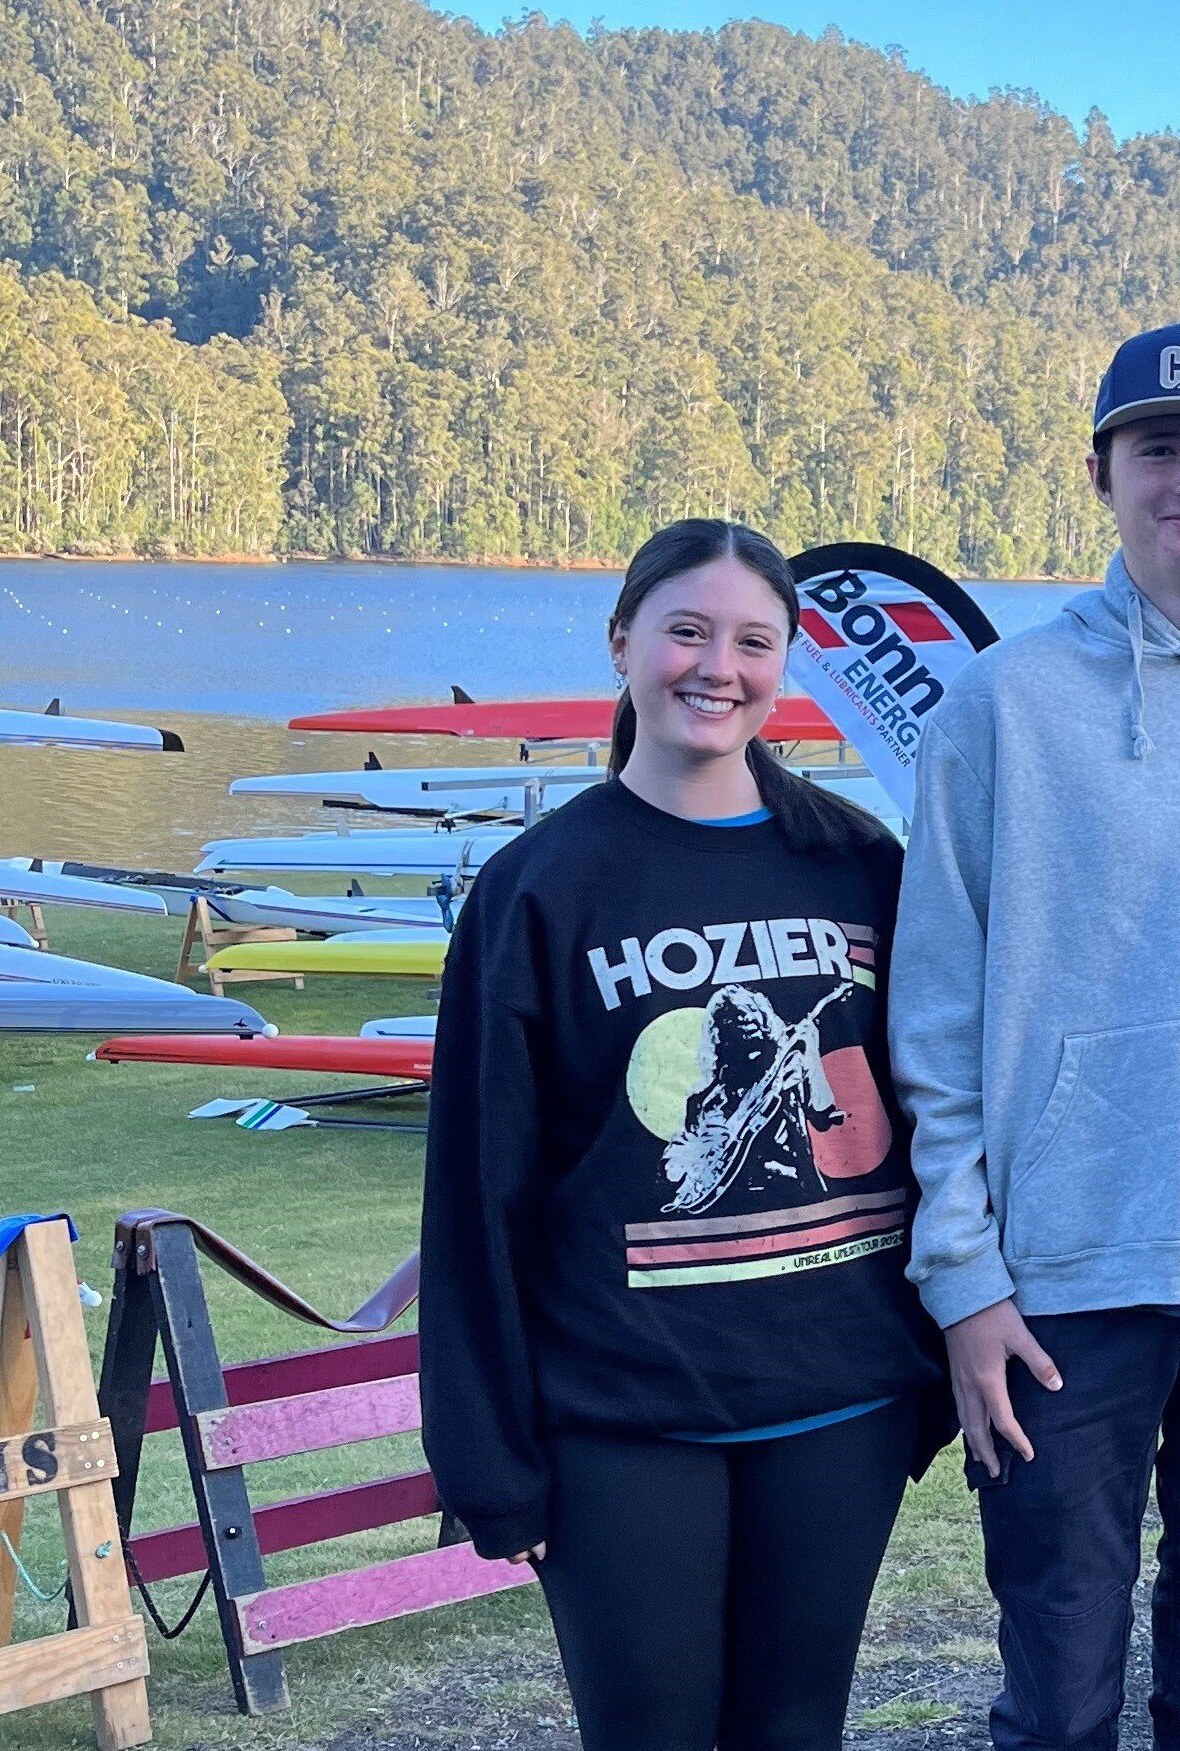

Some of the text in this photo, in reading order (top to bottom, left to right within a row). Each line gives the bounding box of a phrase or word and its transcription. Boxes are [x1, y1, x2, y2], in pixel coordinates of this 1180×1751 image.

[802, 639, 911, 767] FUEL & LUBRICANTS PARTNER
[842, 658, 921, 759] ENERG
[588, 918, 853, 1011] HOZIER
[793, 1251, 832, 1268] UNREAL
[880, 1232, 903, 1248] 202
